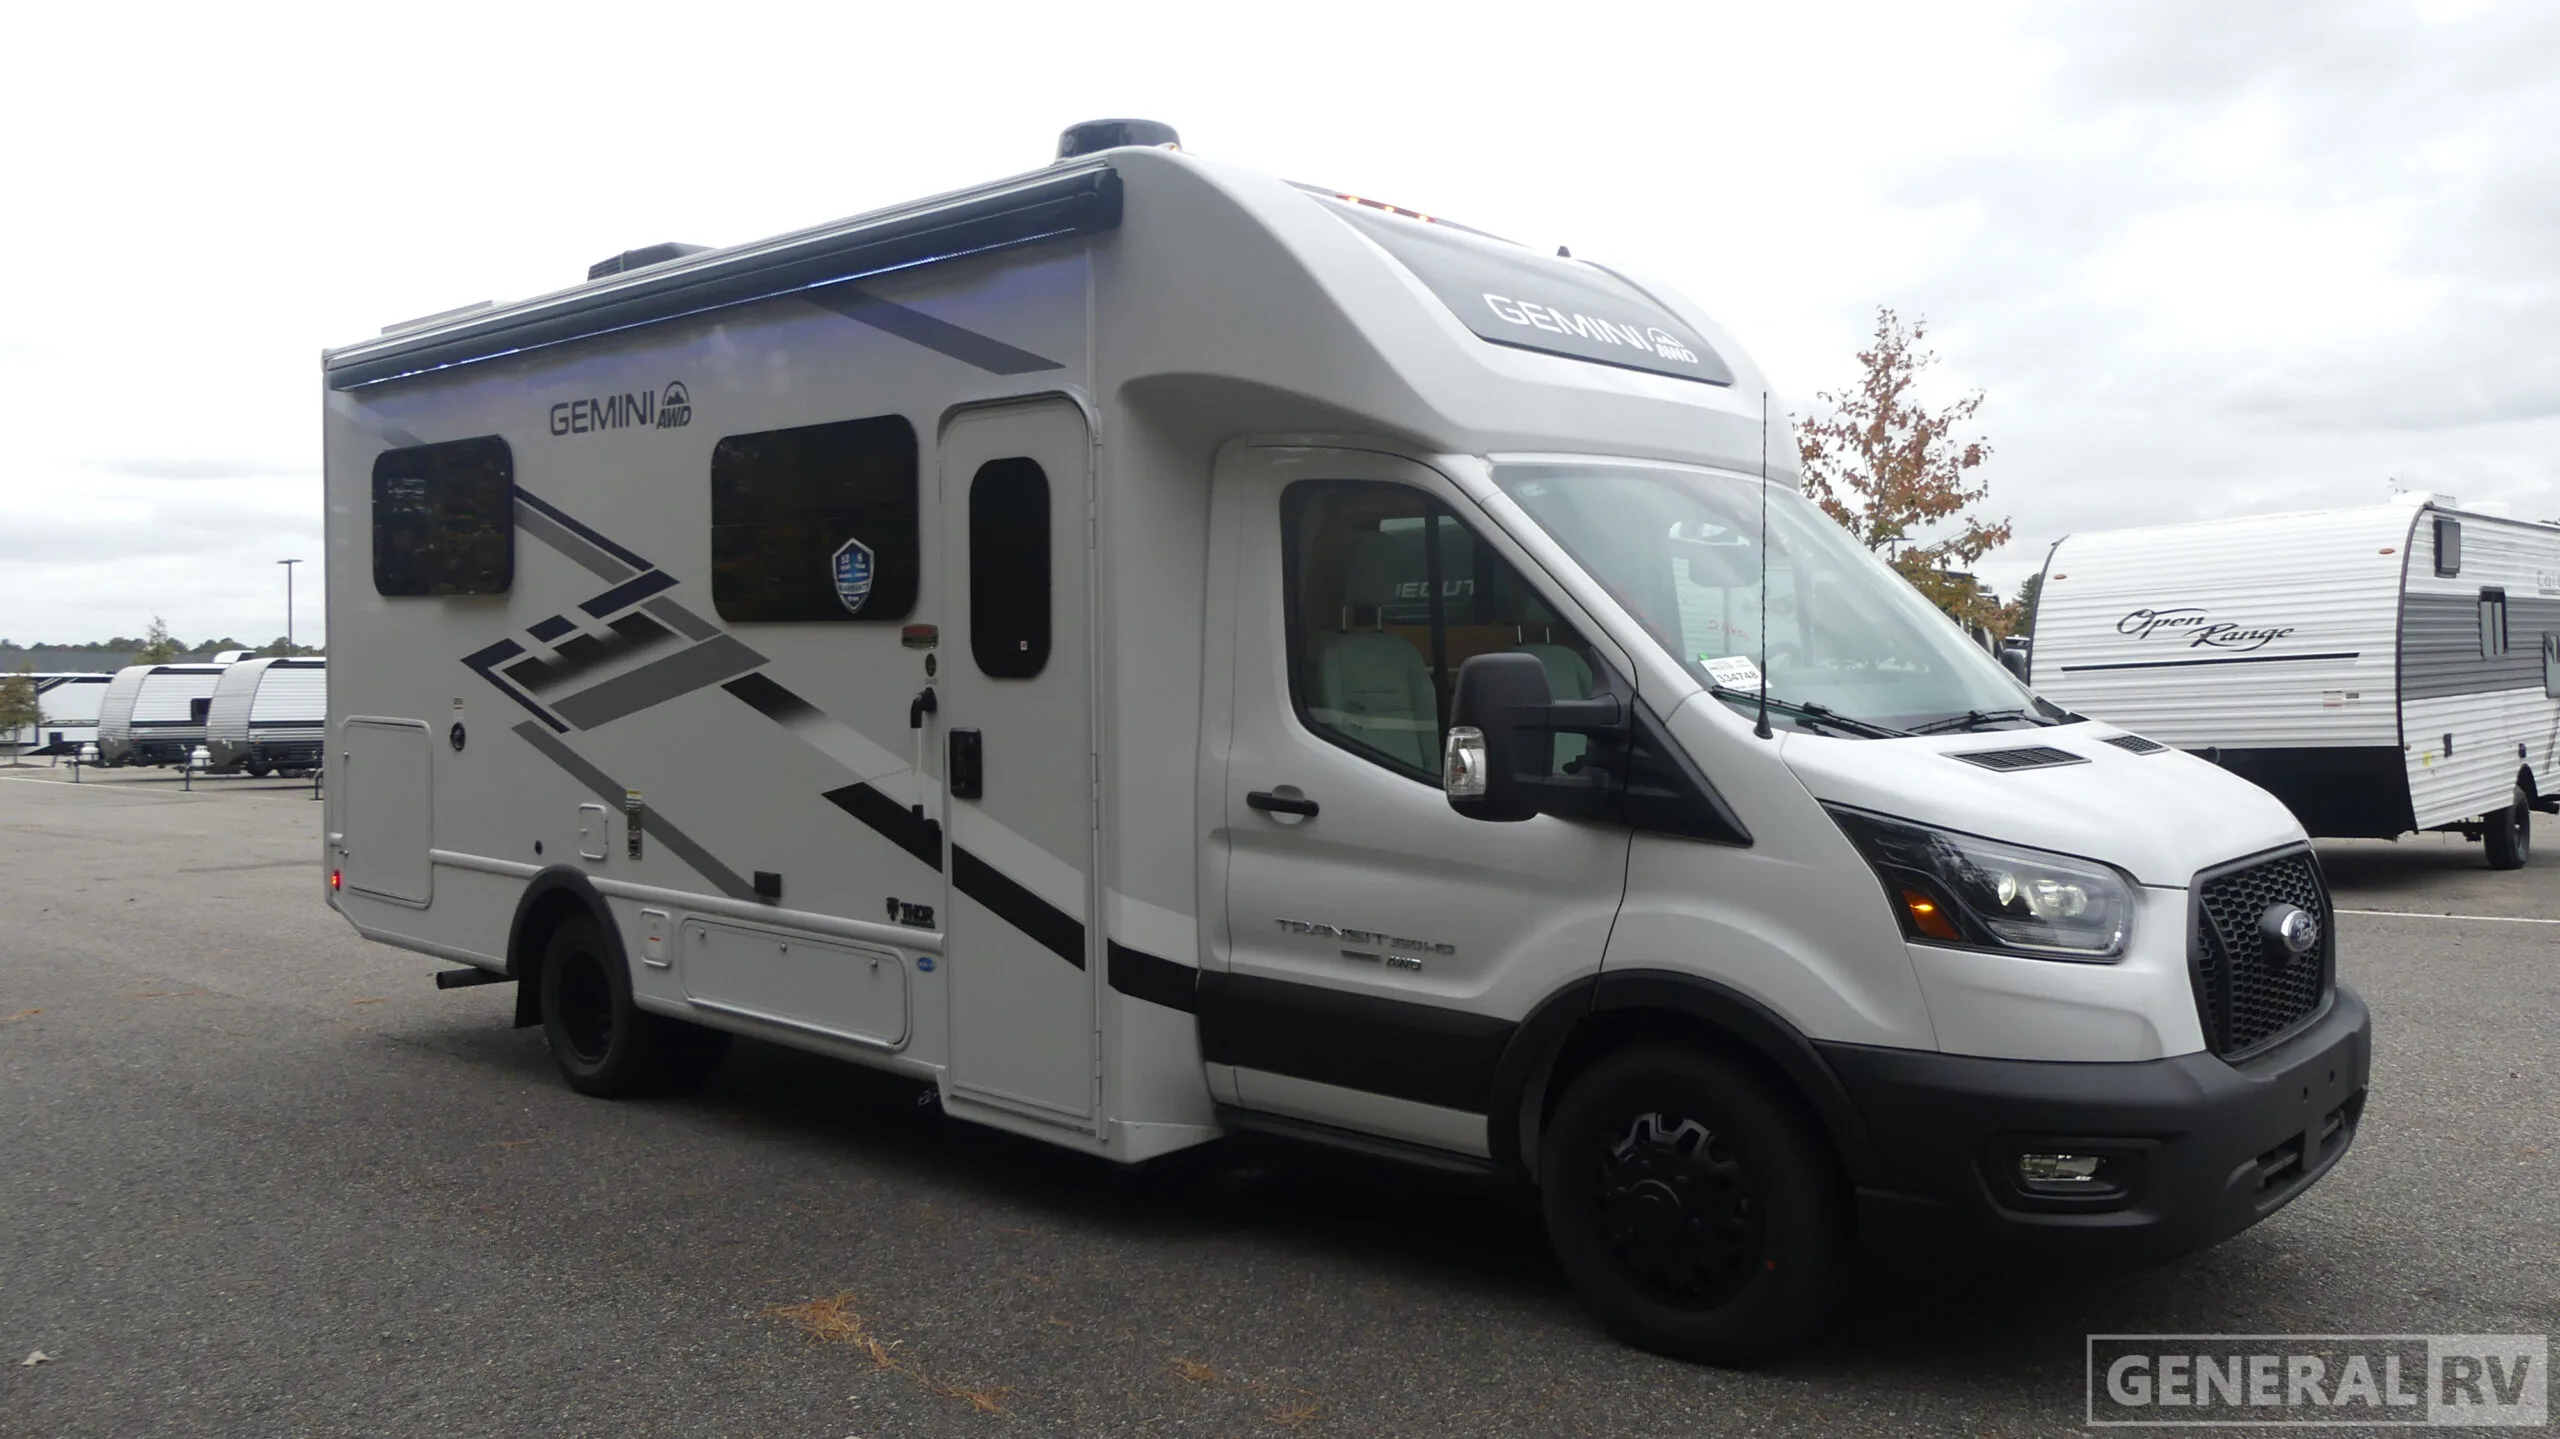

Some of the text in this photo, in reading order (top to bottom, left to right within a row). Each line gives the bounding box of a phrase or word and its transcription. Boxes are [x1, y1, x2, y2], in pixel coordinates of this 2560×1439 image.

[1483, 293, 1698, 364] GEMINI AWD
[550, 390, 692, 436] GEMINI AWD
[2116, 608, 2209, 640] Open
[2183, 622, 2295, 652] Range
[1275, 917, 1389, 946] TRANSIT
[1386, 955, 1422, 971] AWD
